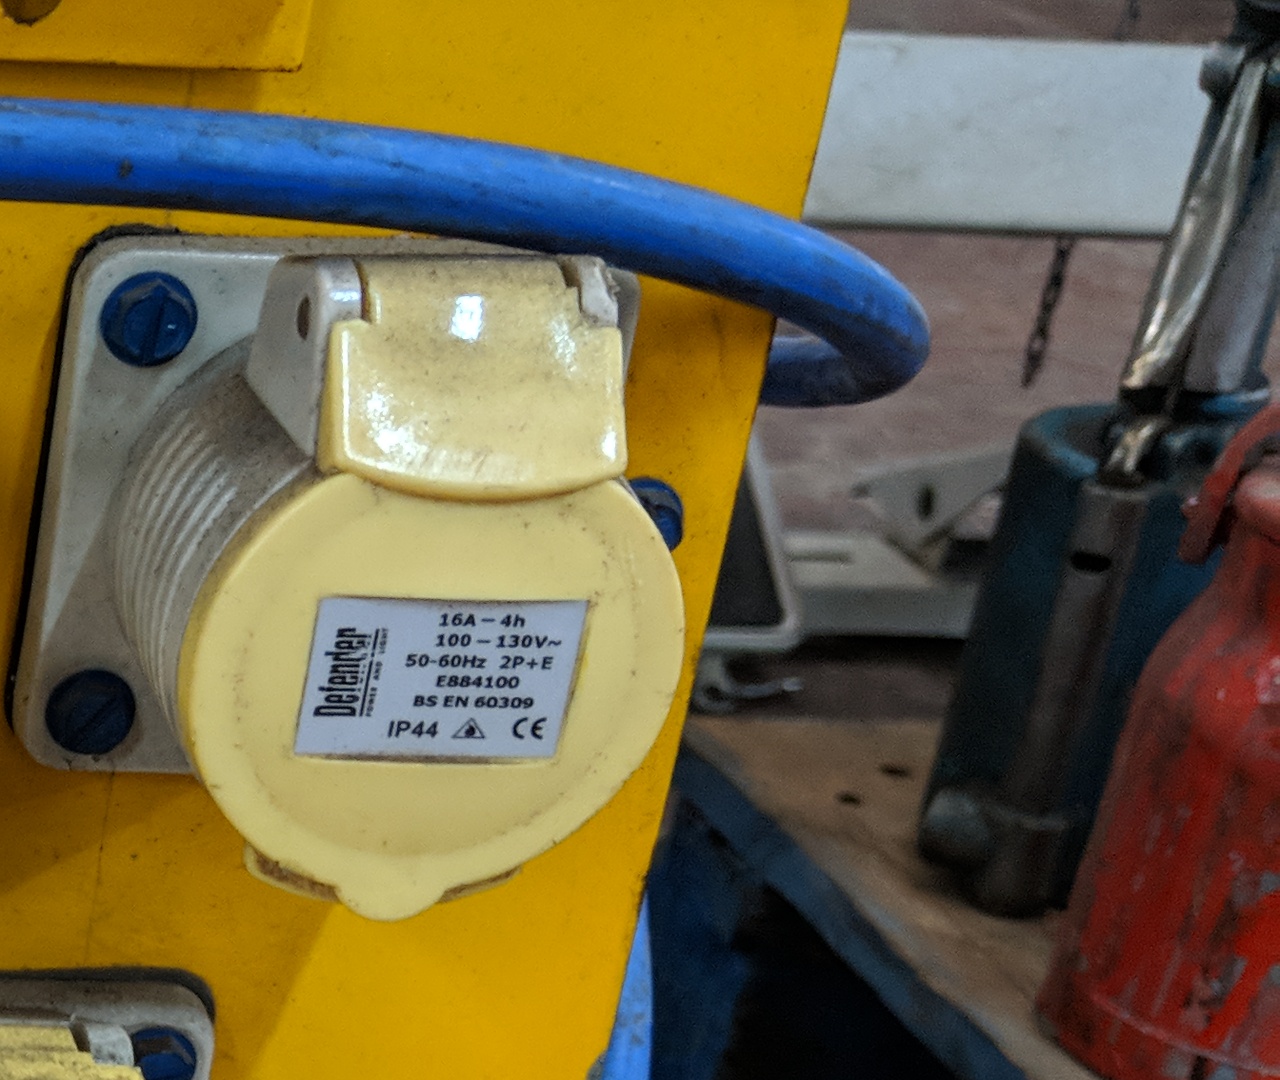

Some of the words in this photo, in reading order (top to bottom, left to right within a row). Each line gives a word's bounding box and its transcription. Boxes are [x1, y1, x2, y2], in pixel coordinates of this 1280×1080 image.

[439, 614, 476, 627] 16A
[500, 614, 524, 627] 4h
[436, 634, 471, 647] 100
[406, 655, 487, 669] 50-60Hz
[436, 677, 520, 688] E884100
[413, 696, 437, 707] BS
[443, 696, 470, 708] EN
[474, 697, 533, 708] 60309
[388, 721, 438, 738] IP44
